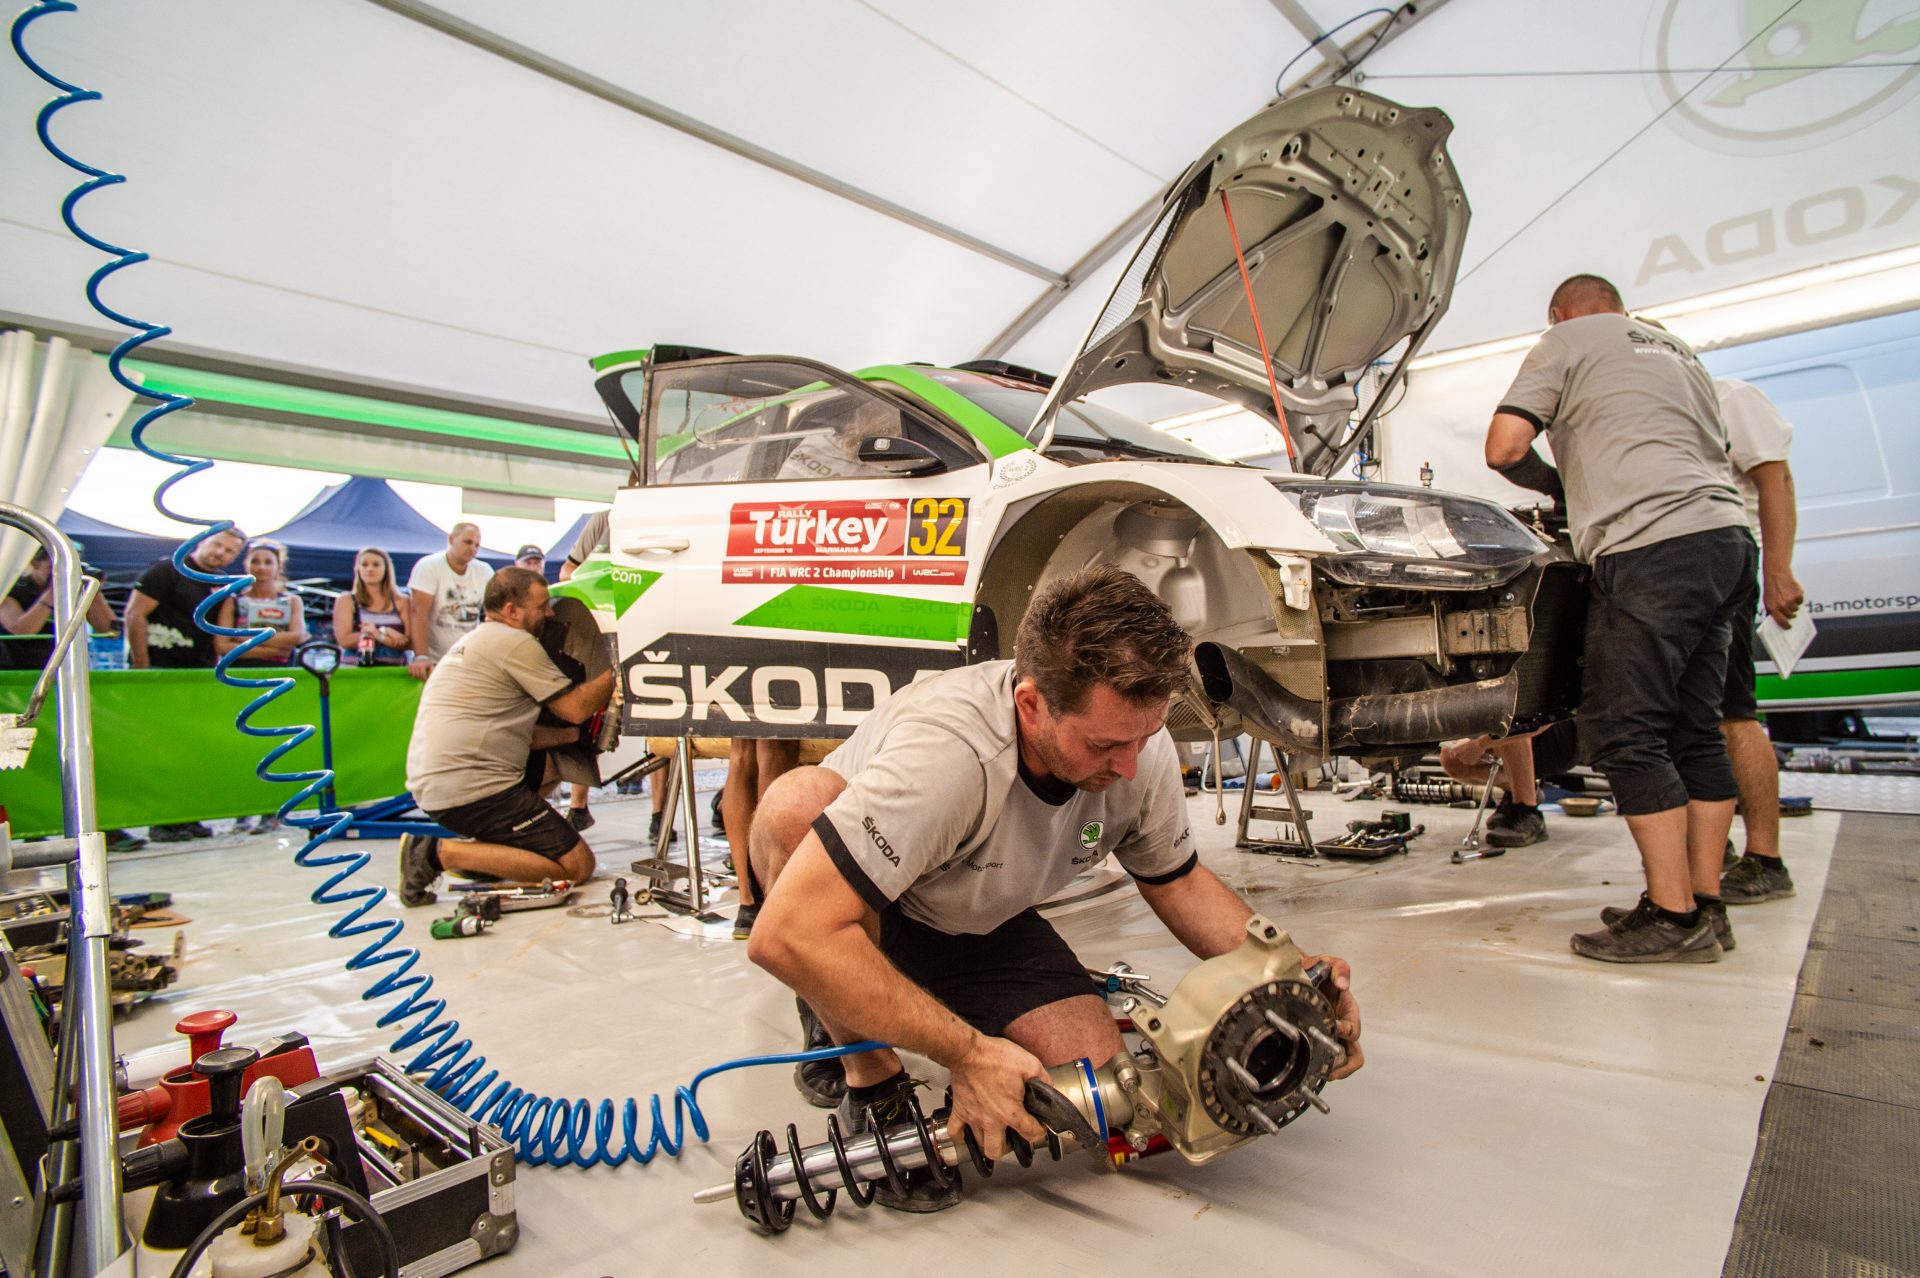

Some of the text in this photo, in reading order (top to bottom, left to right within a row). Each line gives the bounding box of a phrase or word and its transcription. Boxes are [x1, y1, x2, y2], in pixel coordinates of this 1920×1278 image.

[778, 509, 812, 518] RALLY
[910, 497, 964, 555] 32
[750, 509, 888, 553] Turkey
[770, 567, 787, 578] FIA
[788, 567, 811, 578] WRC
[813, 567, 820, 578] 2
[823, 566, 894, 580] Championship
[811, 597, 881, 613] ŠKODA
[1805, 595, 1920, 614] da-motorsp
[629, 650, 944, 726] ŠKOD
[862, 816, 901, 868] ŠKODA
